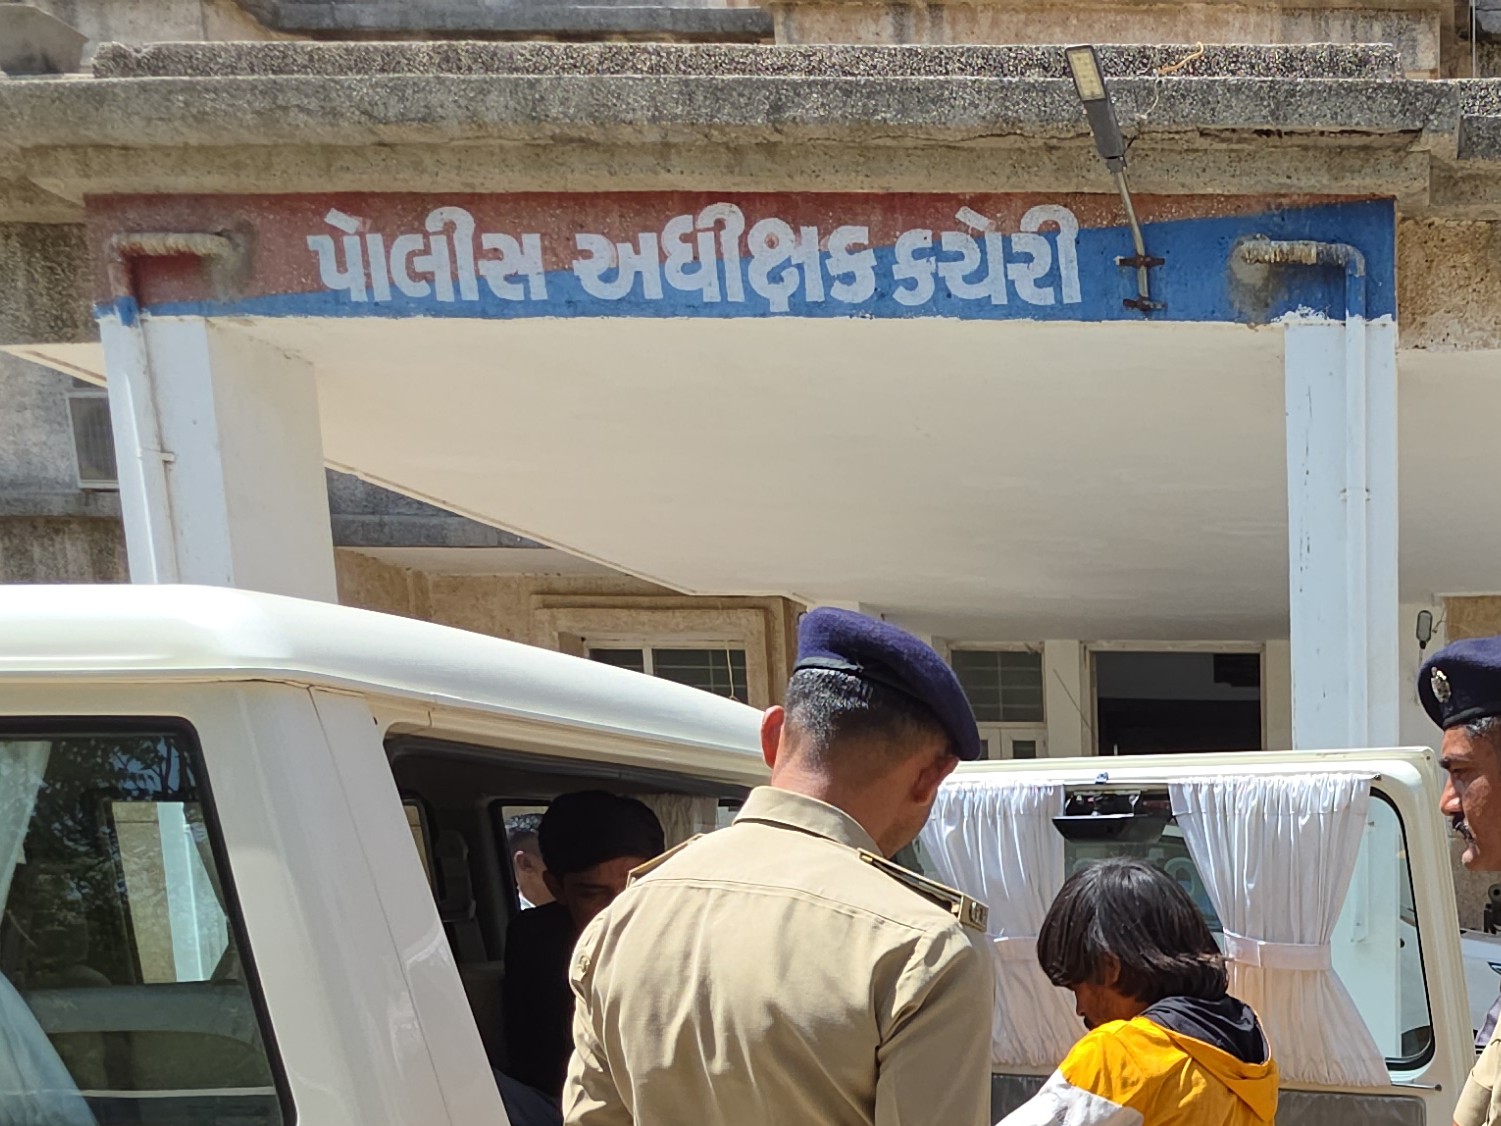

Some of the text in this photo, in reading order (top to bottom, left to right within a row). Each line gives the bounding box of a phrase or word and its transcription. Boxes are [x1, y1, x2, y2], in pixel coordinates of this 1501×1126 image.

[306, 202, 1083, 313] પોલીસ અધીક્ષક કચેરી
